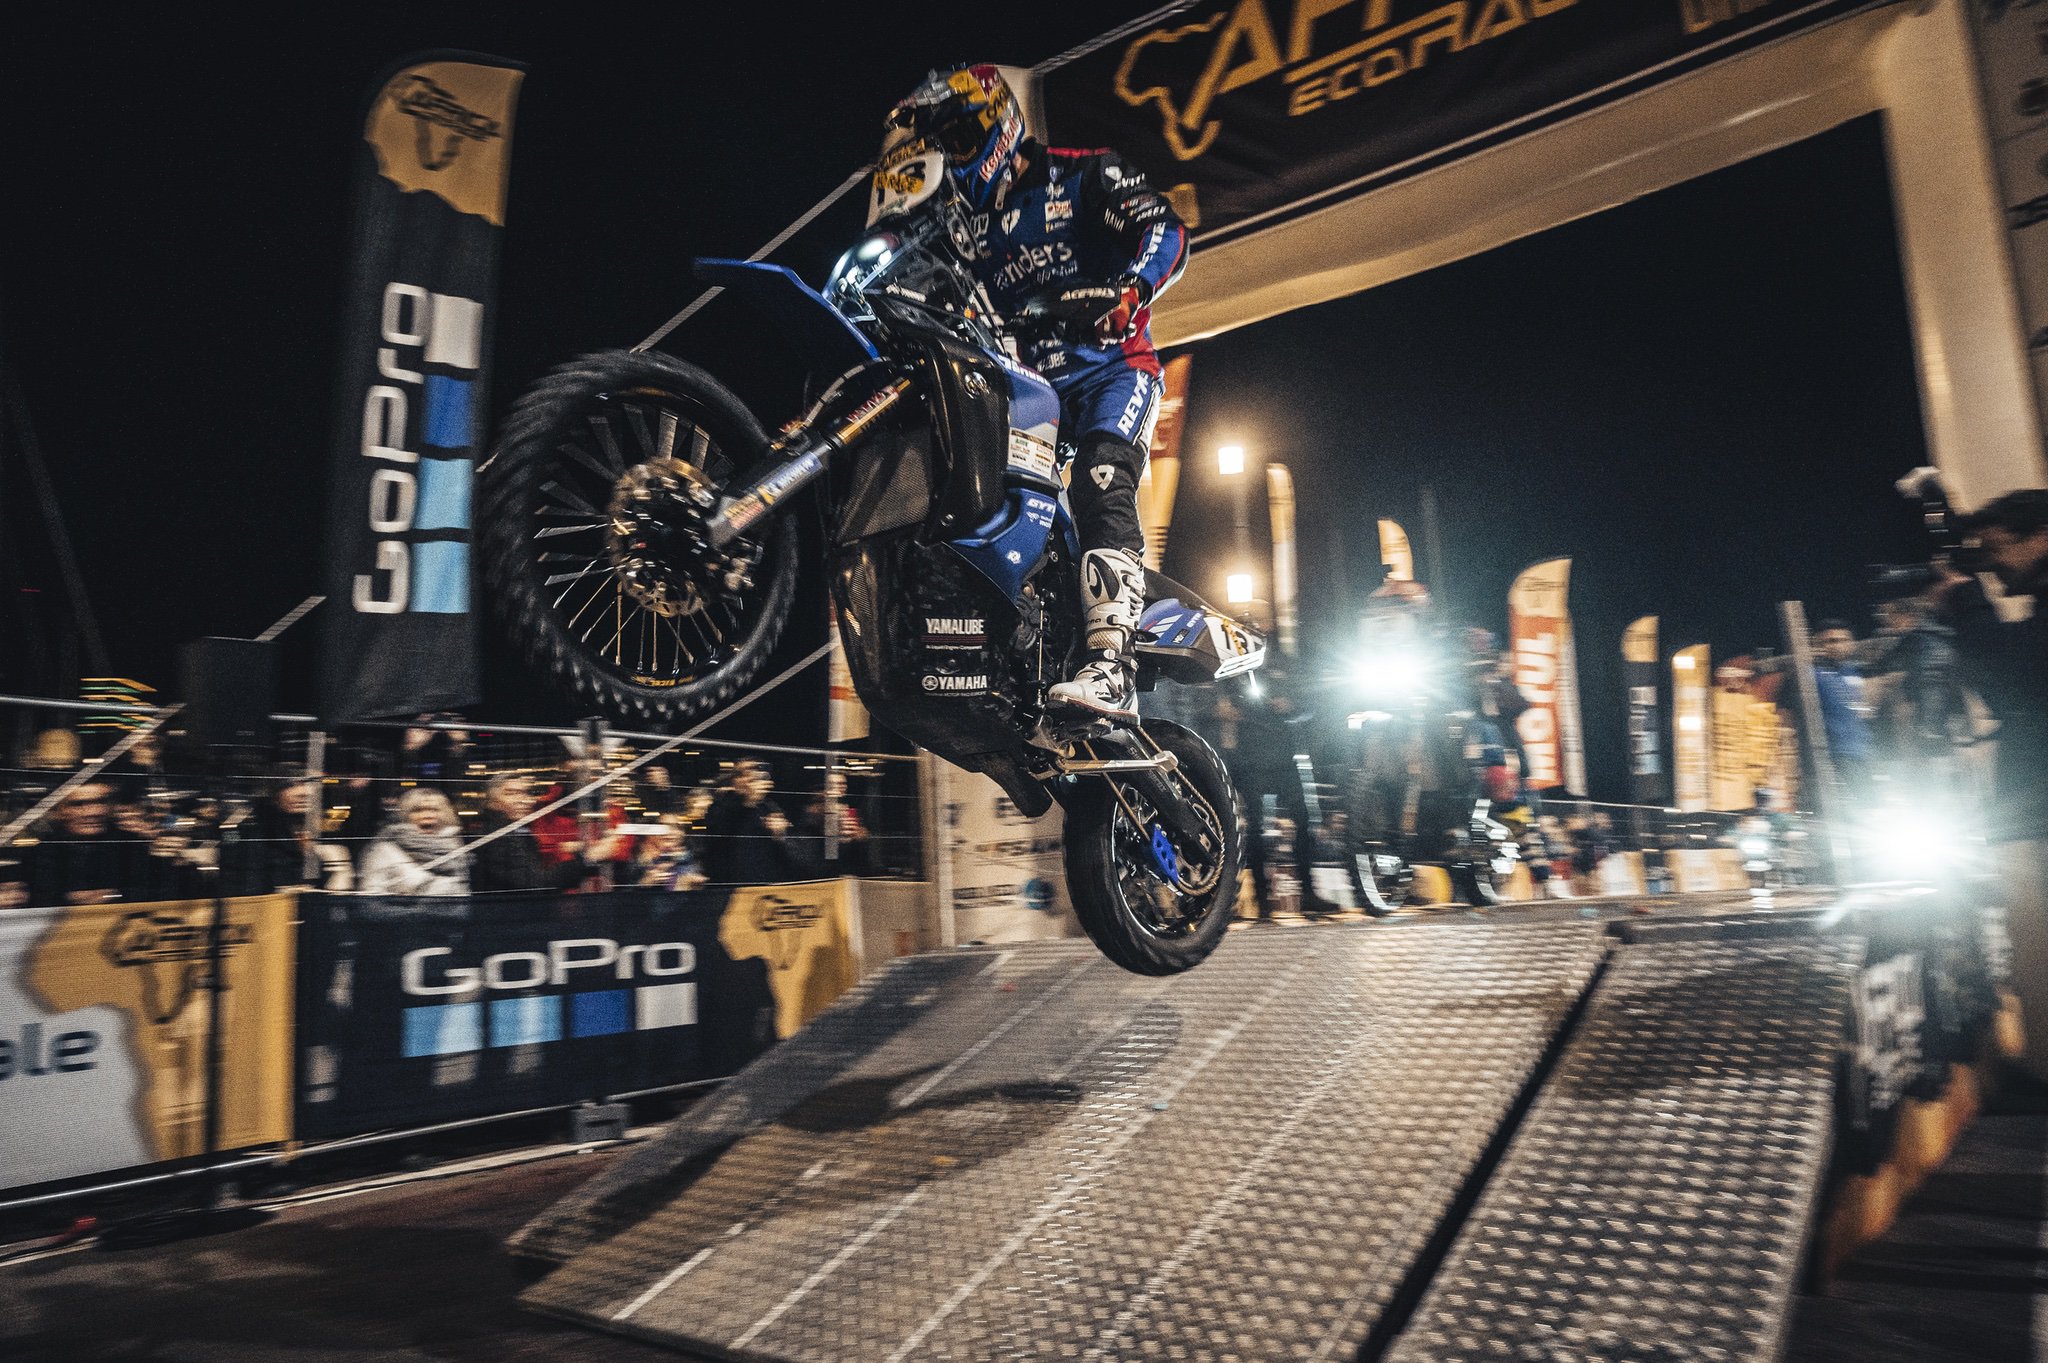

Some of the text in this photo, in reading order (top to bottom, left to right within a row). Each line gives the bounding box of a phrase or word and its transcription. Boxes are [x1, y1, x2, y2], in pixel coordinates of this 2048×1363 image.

[351, 281, 429, 614] GoPro
[926, 617, 985, 634] YAMALUBE
[938, 675, 988, 690] YAMAHA
[400, 937, 697, 996] GoPro
